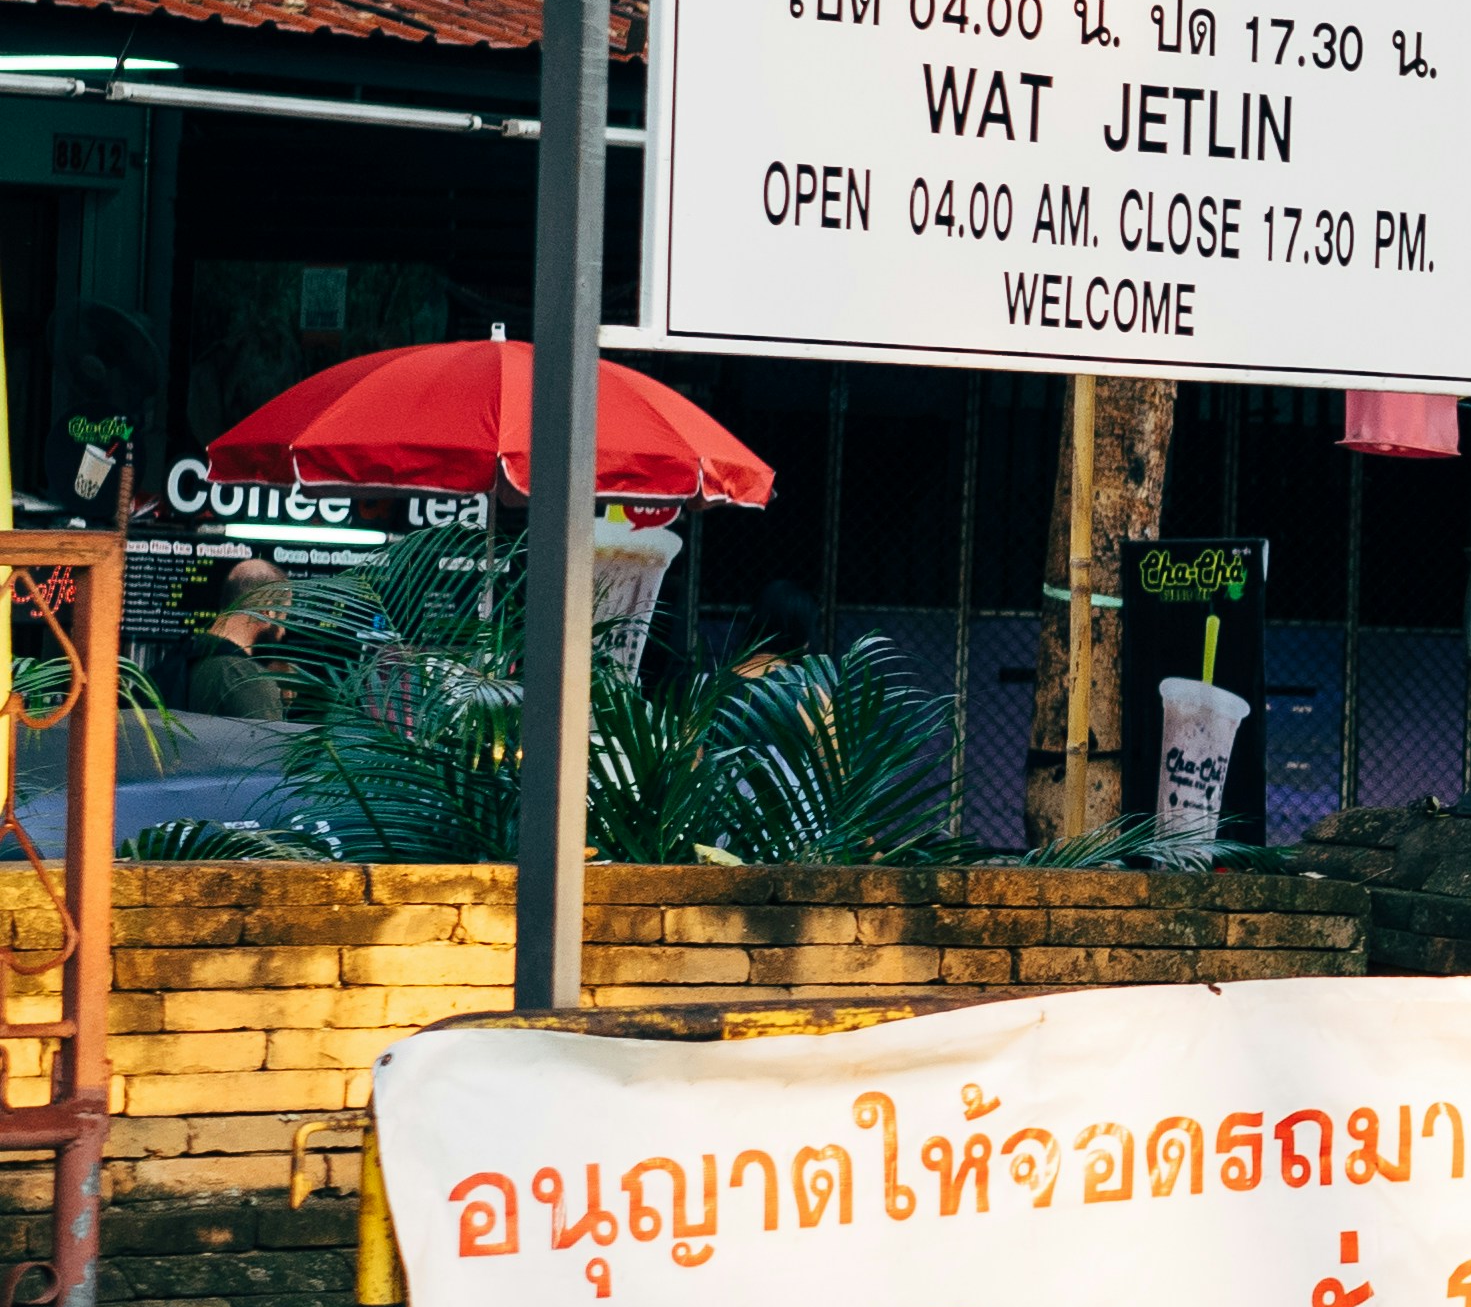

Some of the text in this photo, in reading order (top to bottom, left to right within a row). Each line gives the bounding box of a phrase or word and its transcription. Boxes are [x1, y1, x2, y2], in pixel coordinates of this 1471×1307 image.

[1245, 16, 1364, 72] 17.30
[1392, 29, 1438, 80] น.
[922, 63, 1292, 163] WAT JETLIN
[763, 160, 1435, 273] OPEN 04.00 AM. CLOSE 17.30 PM.
[1004, 271, 1196, 337] WELCOME
